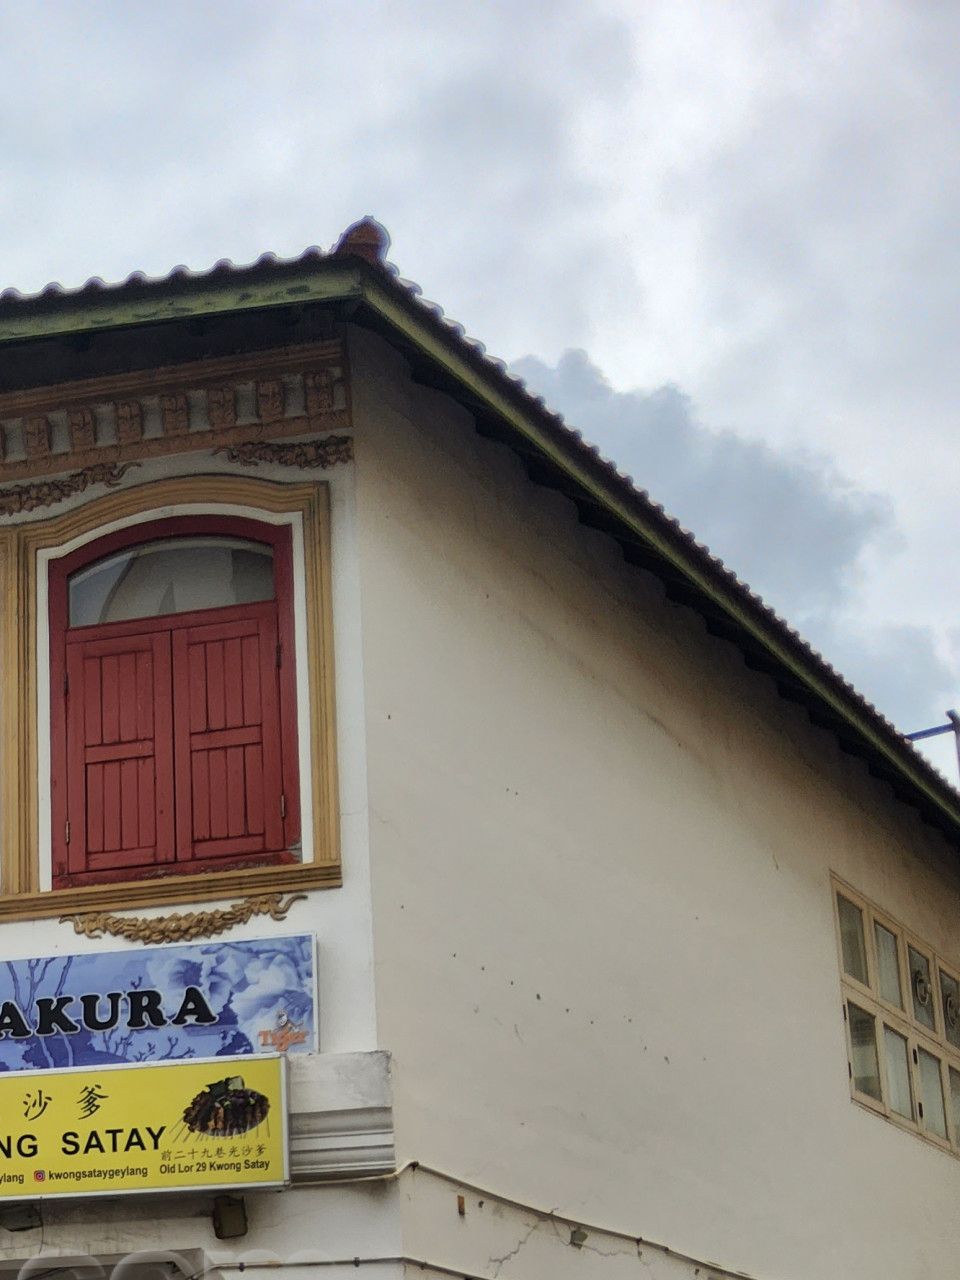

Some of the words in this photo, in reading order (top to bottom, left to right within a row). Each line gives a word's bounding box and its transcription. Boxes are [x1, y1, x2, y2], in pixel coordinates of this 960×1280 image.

[61, 1125, 166, 1156] SATAY
[48, 1165, 148, 1181] kwongsataygeylang
[160, 1163, 176, 1175] Old
[178, 1162, 193, 1174] Lor
[196, 1161, 207, 1173] 29
[209, 1160, 241, 1173] Kwong
[244, 1159, 270, 1171] Satay
